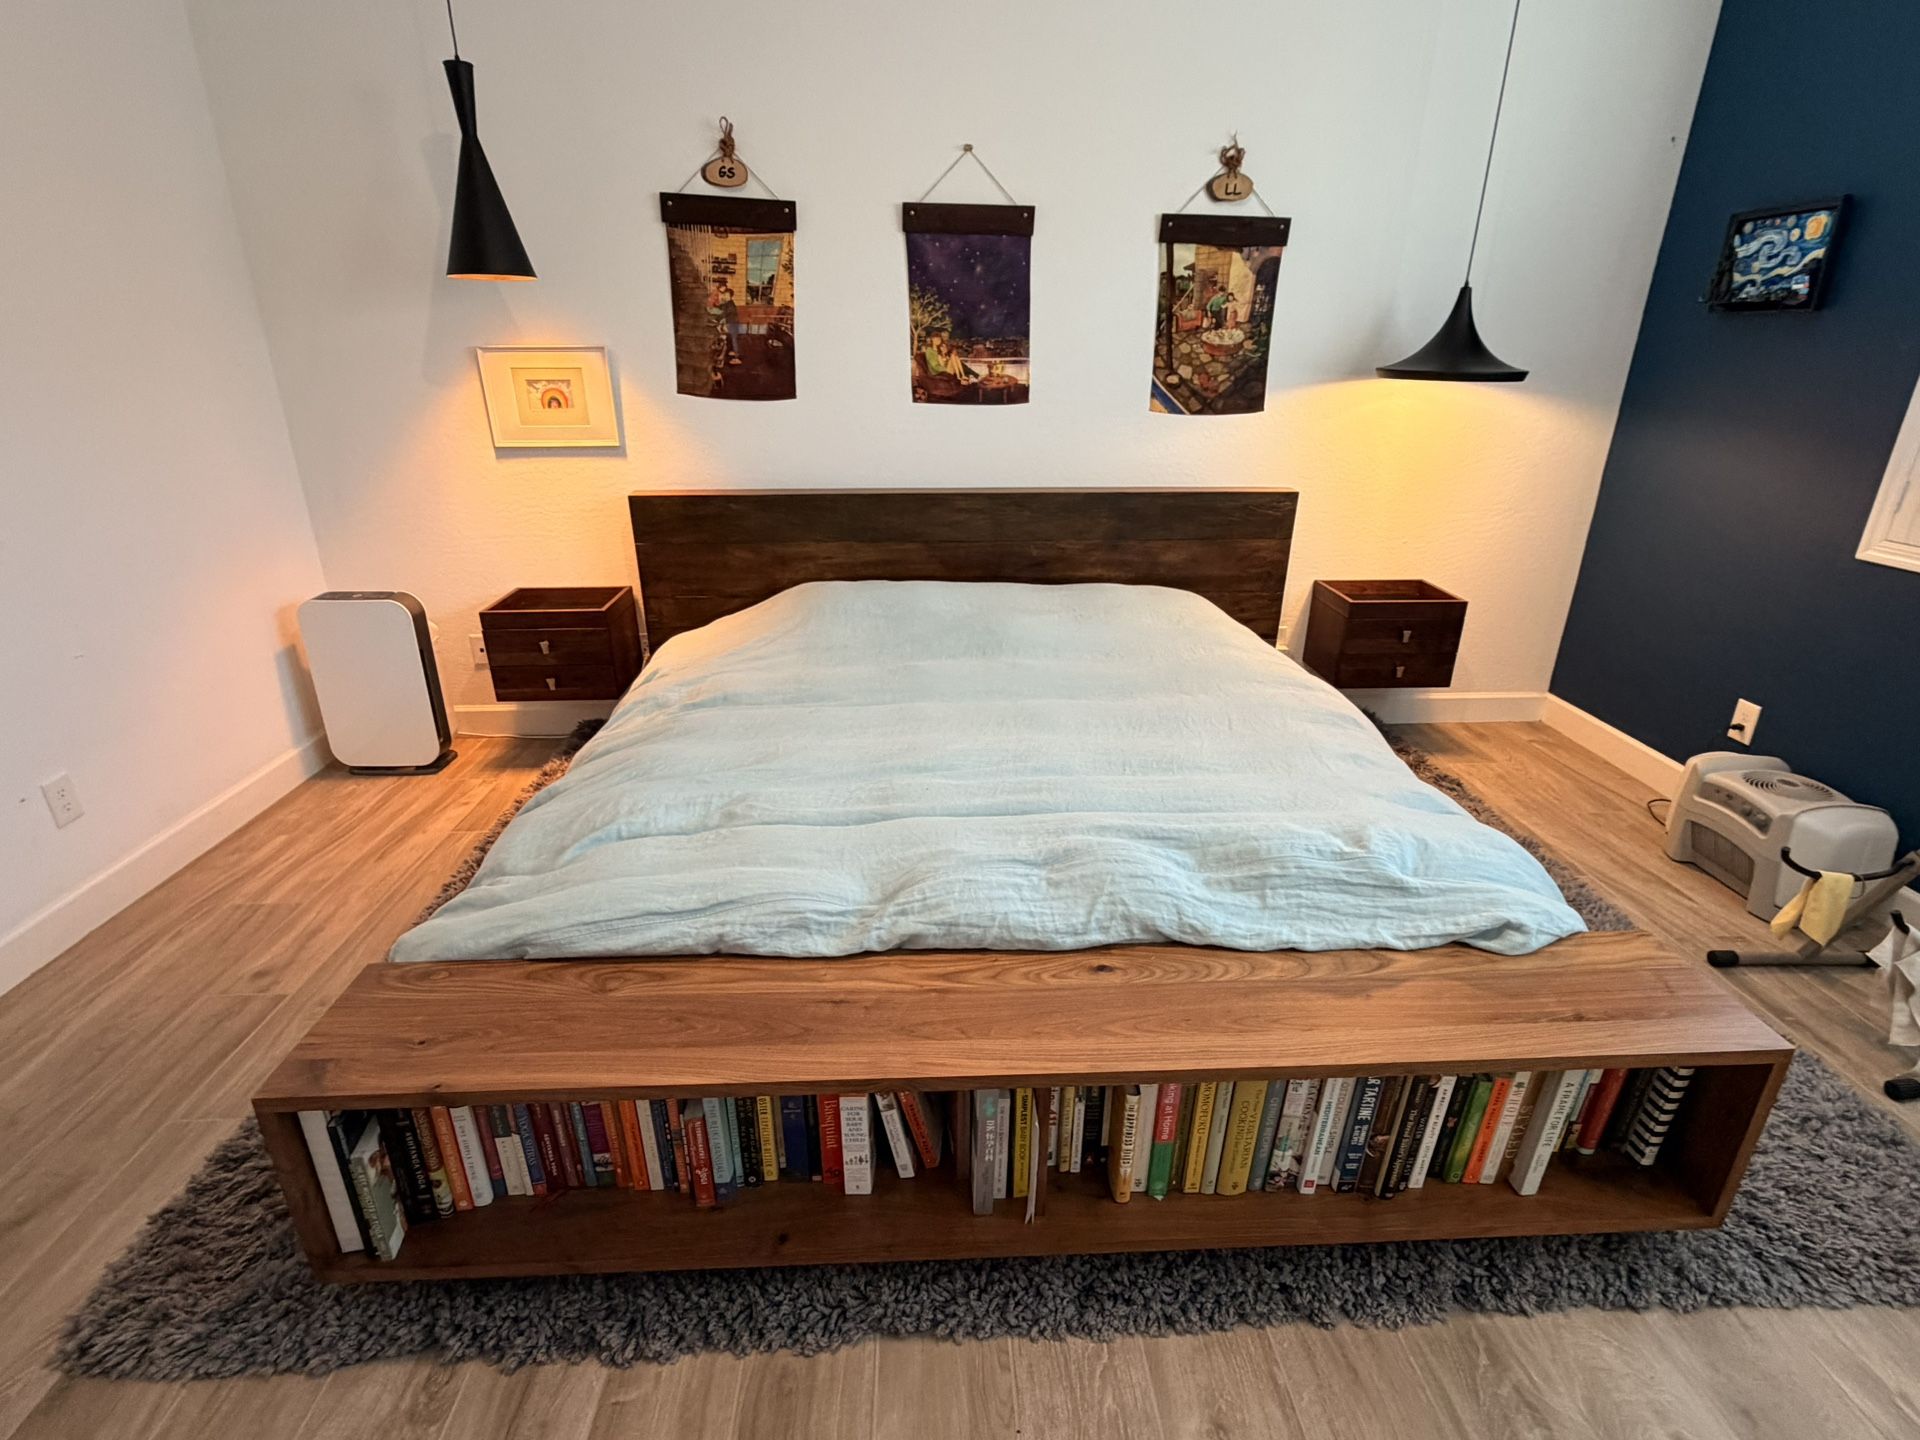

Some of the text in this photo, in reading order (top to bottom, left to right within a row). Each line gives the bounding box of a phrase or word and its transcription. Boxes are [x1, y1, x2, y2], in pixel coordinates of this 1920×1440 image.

[718, 165, 736, 179] GS
[1224, 182, 1242, 196] LL
[1020, 1094, 1029, 1125] SIMPLEST
[1164, 1105, 1173, 1114] at
[1331, 1081, 1348, 1130] OTTOLENGHI
[1357, 1086, 1380, 1121] TARTINE
[1555, 1089, 1572, 1115] FRAME
[820, 1099, 839, 1150] Basquiat
[1235, 1101, 1250, 1140] COOKING
[1409, 1109, 1418, 1121] The
[1547, 1116, 1560, 1130] FOR
[1124, 1113, 1136, 1147] HAPPINESS
[1161, 1115, 1173, 1140] Home
[1314, 1101, 1332, 1155] MEDITERRANEAN
[1402, 1121, 1414, 1137] Bread
[1415, 1117, 1427, 1139] WATER
[1429, 1121, 1439, 1139] BEAUTY
[1504, 1105, 1534, 1159] STYLED
[1542, 1131, 1555, 1147] LIFE
[1240, 1112, 1258, 1169] VEGETARIAN
[1324, 1131, 1338, 1154] SIMPLE
[414, 1170, 427, 1190] YOGA
